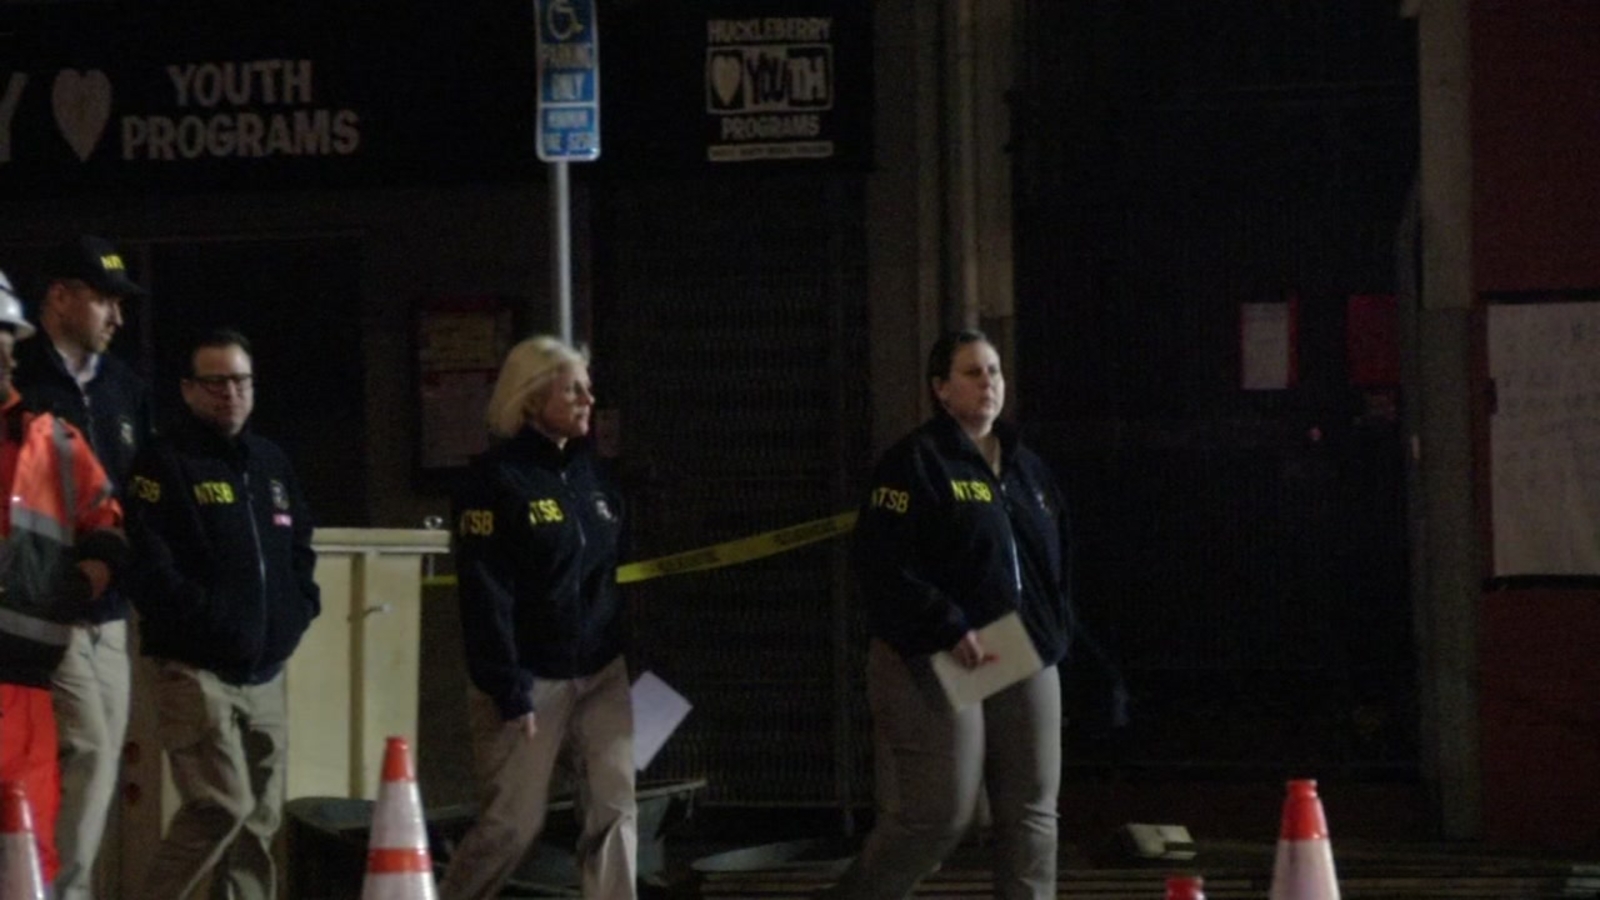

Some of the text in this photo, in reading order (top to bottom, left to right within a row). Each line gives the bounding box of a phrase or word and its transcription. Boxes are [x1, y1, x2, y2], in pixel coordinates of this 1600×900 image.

[166, 58, 313, 107] YOUTH
[120, 109, 361, 161] PROGRAMS
[720, 113, 821, 141] PROGRAMS
[950, 479, 993, 503] NTSB
